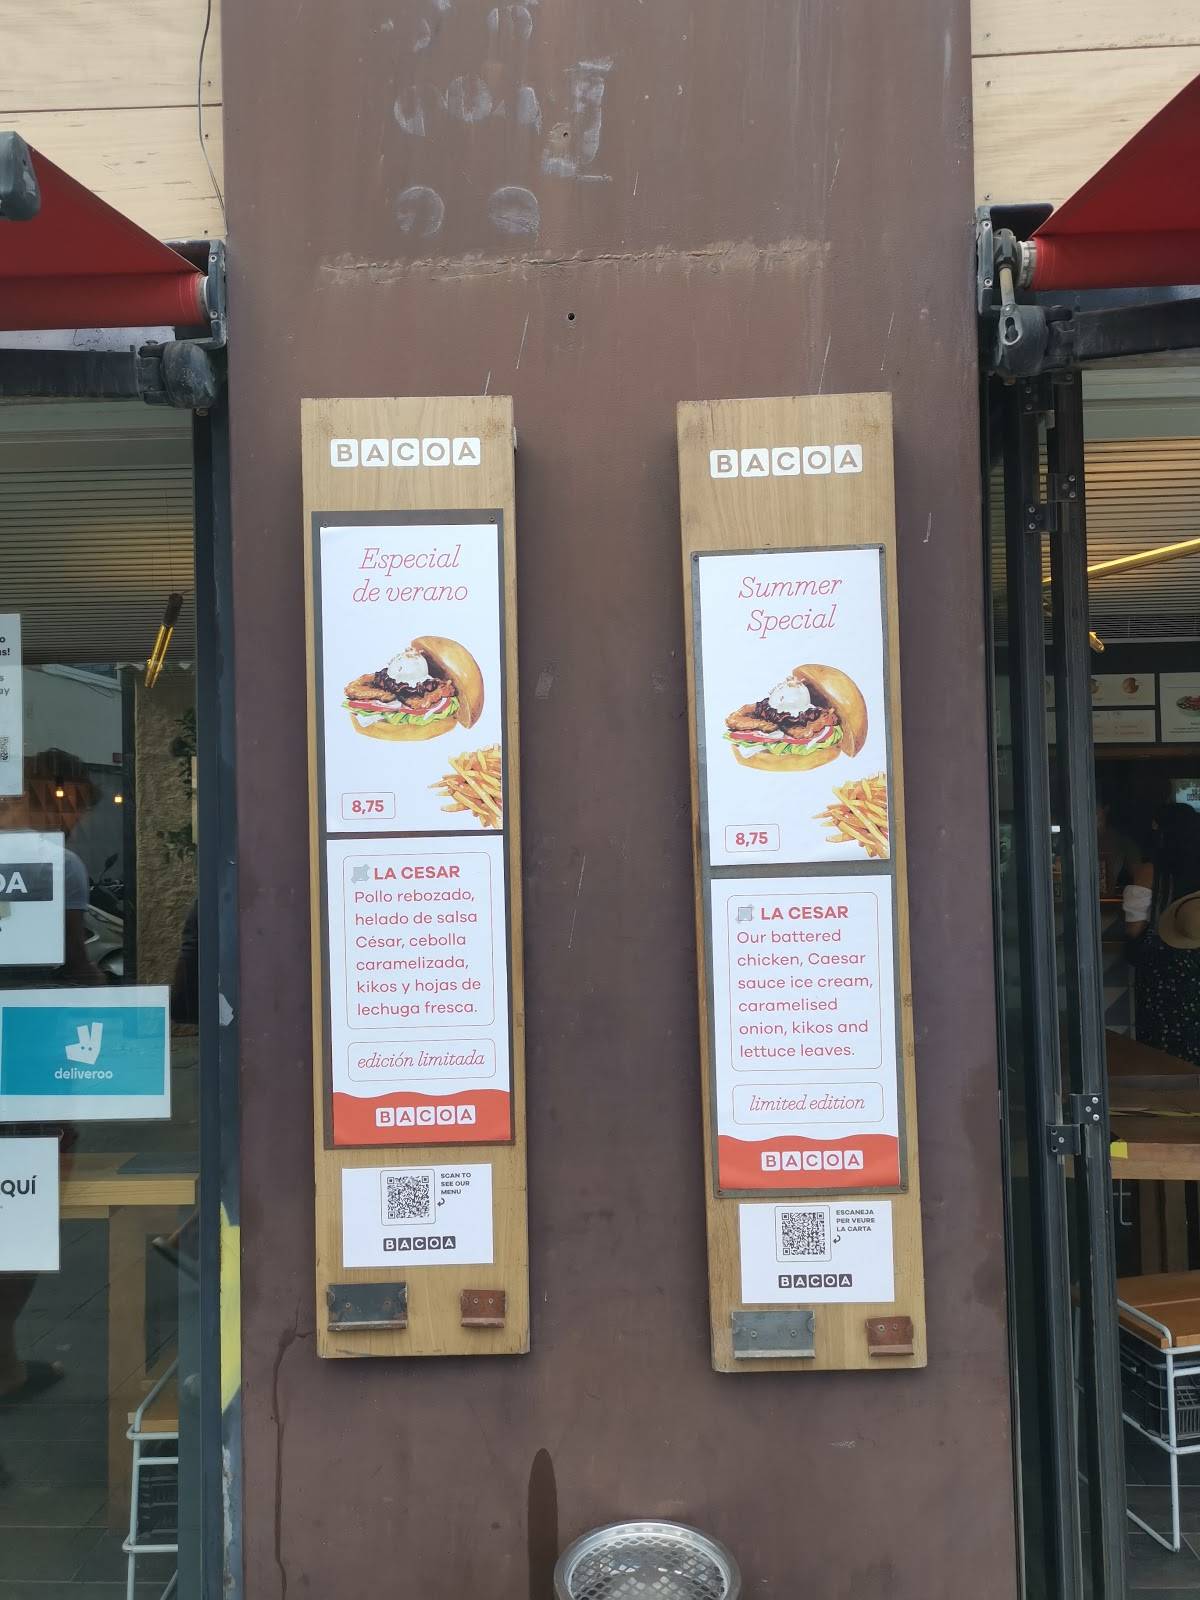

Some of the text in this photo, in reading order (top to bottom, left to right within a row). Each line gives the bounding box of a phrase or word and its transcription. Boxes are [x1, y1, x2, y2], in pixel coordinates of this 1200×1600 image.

[335, 440, 477, 463] BACOA
[715, 448, 860, 474] BACOA
[358, 545, 462, 577] Especial
[352, 578, 468, 602] de verano
[738, 576, 842, 599] Summer
[747, 604, 836, 639] Special
[351, 799, 385, 815] 8,75
[735, 831, 769, 847] 8,75
[374, 865, 461, 880] LA CESAR
[354, 888, 475, 903] Pollo rebozado,
[355, 911, 477, 926] helado de salsa
[761, 905, 849, 921] LA CESAR
[355, 933, 466, 949] César, cebolla
[737, 929, 841, 944] Our battered
[356, 956, 469, 972] caramelizada,
[737, 952, 866, 967] chicken, Caesar
[357, 978, 481, 995] kikos y hojas de
[737, 976, 873, 990] sauce ice cream,
[357, 1001, 478, 1017] lechuga fresca.
[738, 998, 838, 1012] caramelised
[739, 1020, 868, 1036] onion, kikos and
[357, 1049, 485, 1069] edición limitada
[740, 1044, 855, 1058] lettuce leaves.
[54, 1067, 114, 1080] deliveroo
[749, 1093, 865, 1111] limited edition
[379, 1107, 473, 1125] BACOA
[765, 1152, 861, 1169] BACOA
[385, 1236, 455, 1251] BACOA
[779, 1274, 852, 1288] BACOA
